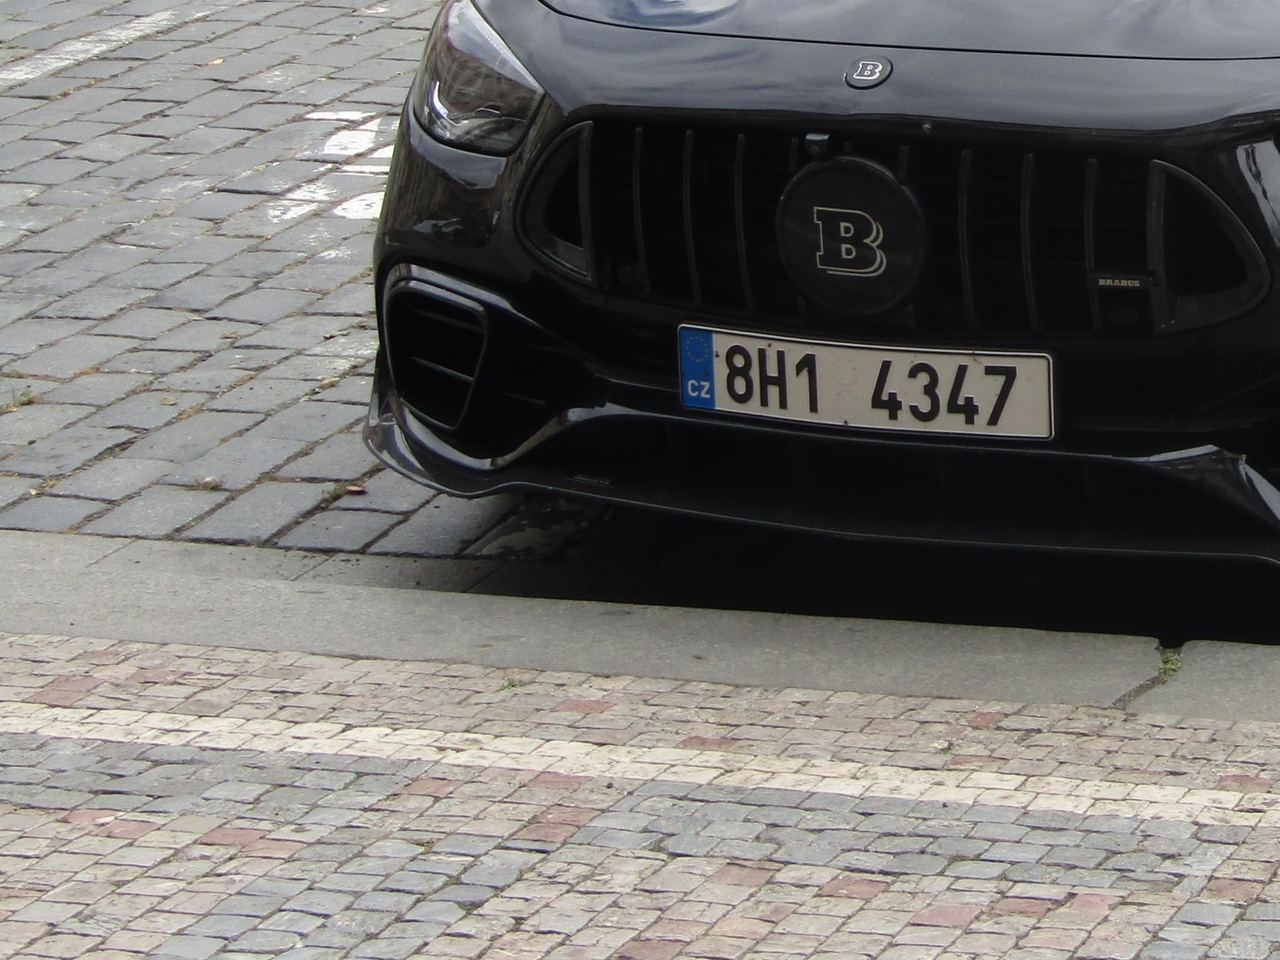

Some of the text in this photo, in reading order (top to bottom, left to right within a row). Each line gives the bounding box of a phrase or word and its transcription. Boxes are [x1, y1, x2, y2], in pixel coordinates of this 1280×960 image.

[852, 61, 884, 81] B
[813, 206, 888, 277] B
[1098, 278, 1141, 287] BRABUS
[687, 343, 1018, 426] CZ 8H1 4347
